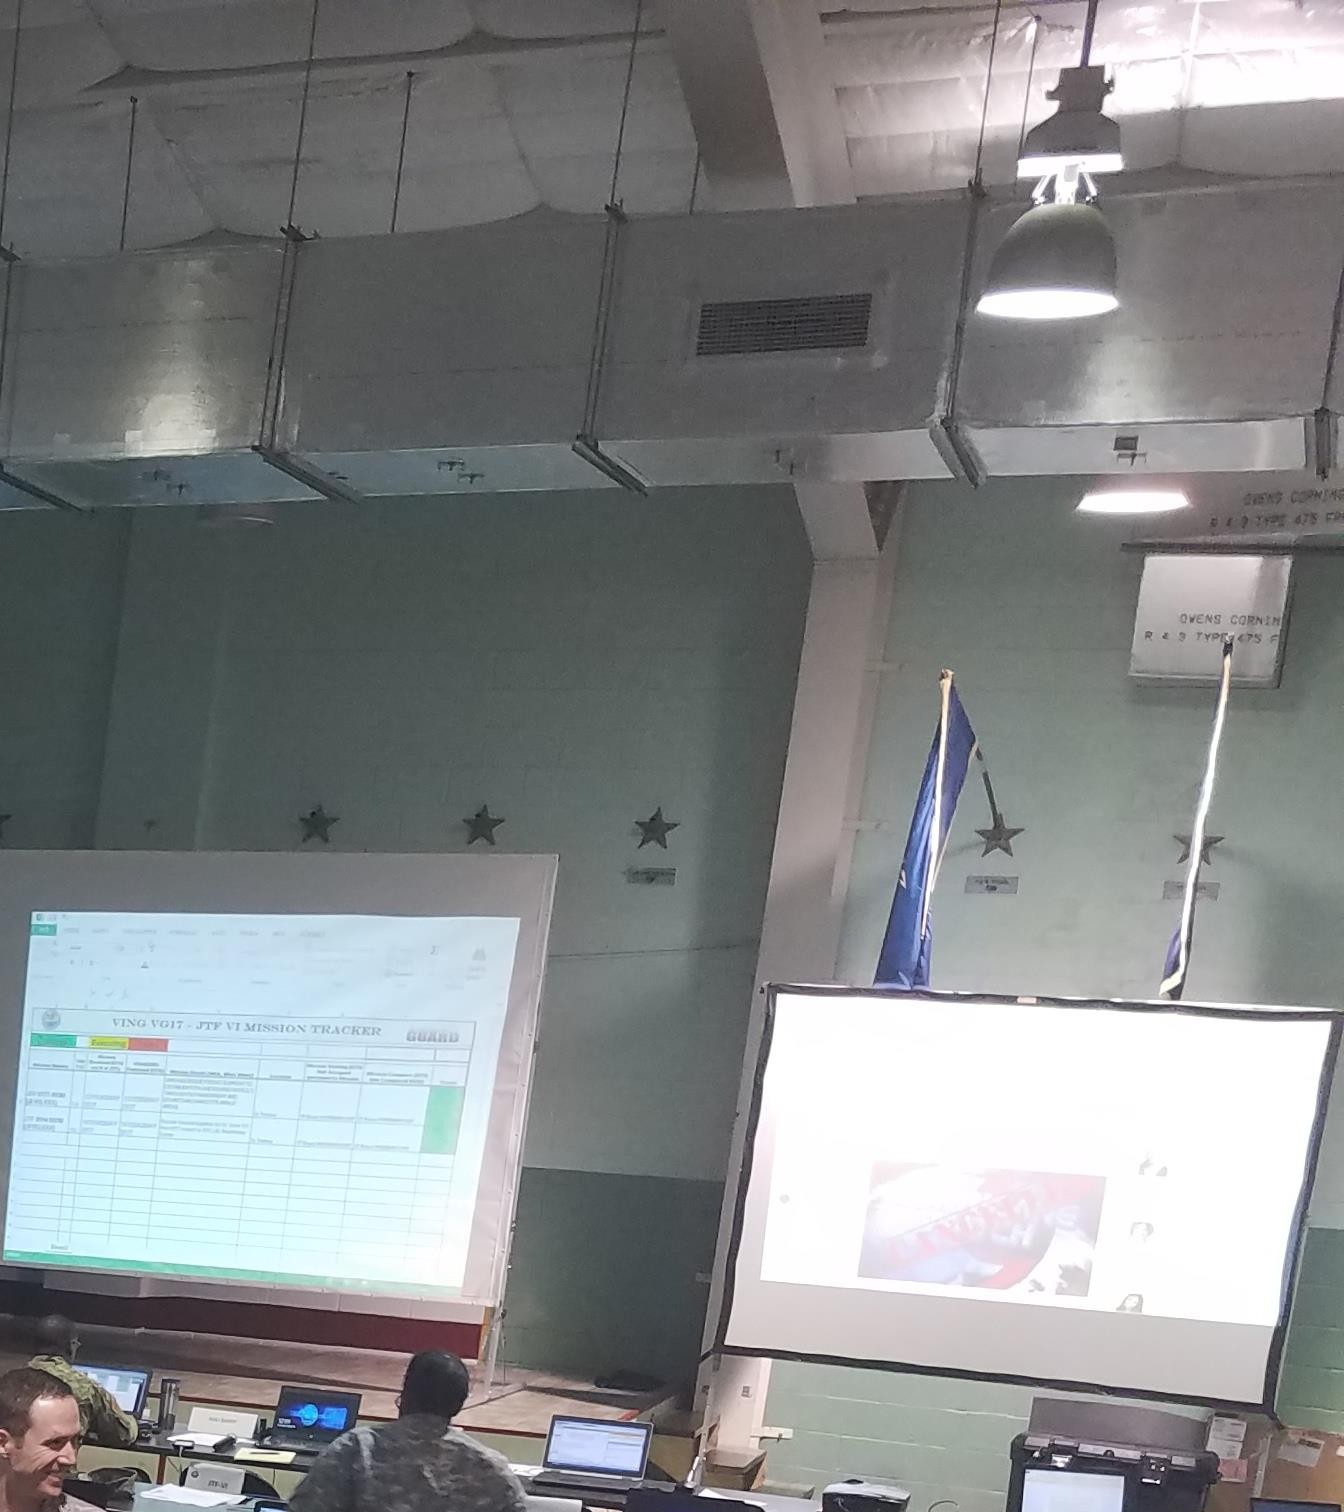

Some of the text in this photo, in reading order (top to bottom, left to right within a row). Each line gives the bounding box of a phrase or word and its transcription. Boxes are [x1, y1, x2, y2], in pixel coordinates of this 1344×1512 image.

[1179, 613, 1222, 625] OWENS
[112, 1018, 147, 1029] VING
[151, 1019, 184, 1031] VG17
[195, 1021, 223, 1032] JTF
[226, 1022, 241, 1033] VI
[243, 1023, 307, 1035] MISSION
[311, 1024, 382, 1037] TRACKER
